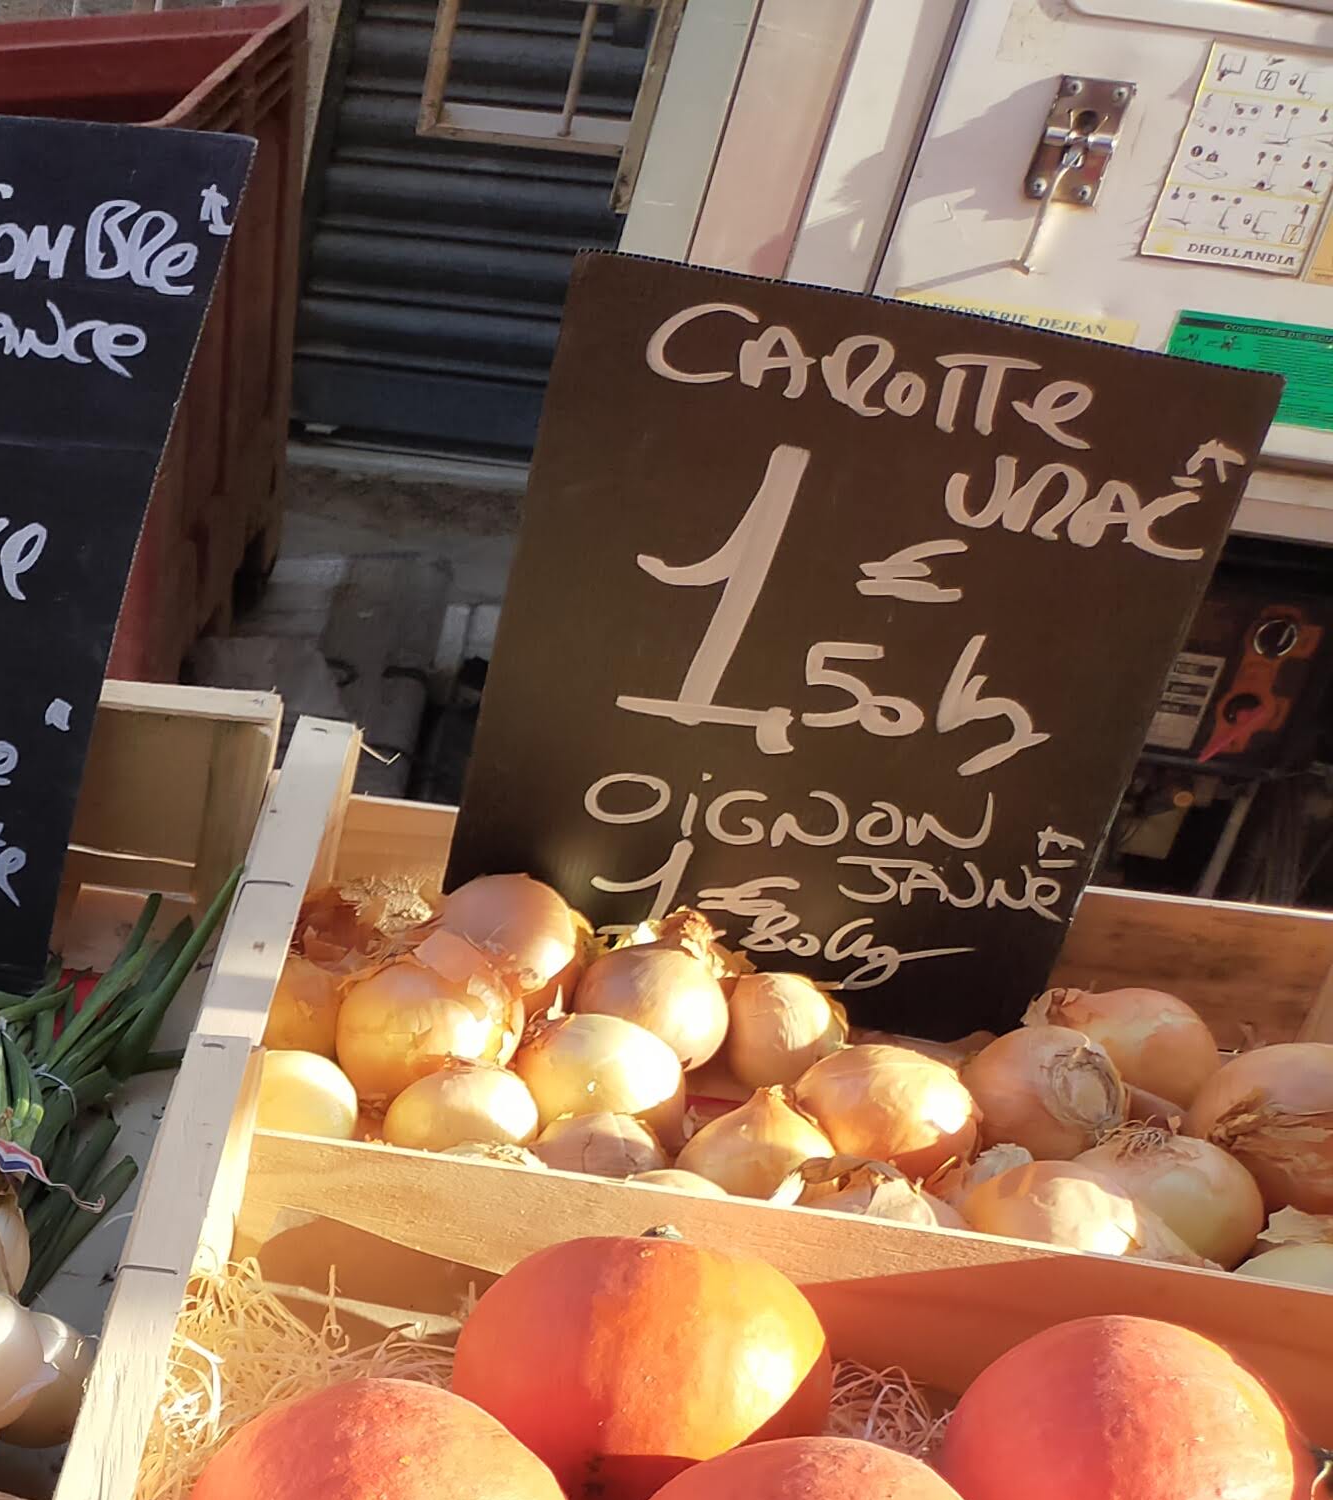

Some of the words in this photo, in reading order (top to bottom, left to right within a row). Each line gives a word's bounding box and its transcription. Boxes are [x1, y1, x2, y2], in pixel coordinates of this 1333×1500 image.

[1187, 243, 1296, 267] DHOLLANDIA
[1037, 316, 1107, 336] DEJEAN
[856, 540, 969, 602] €
